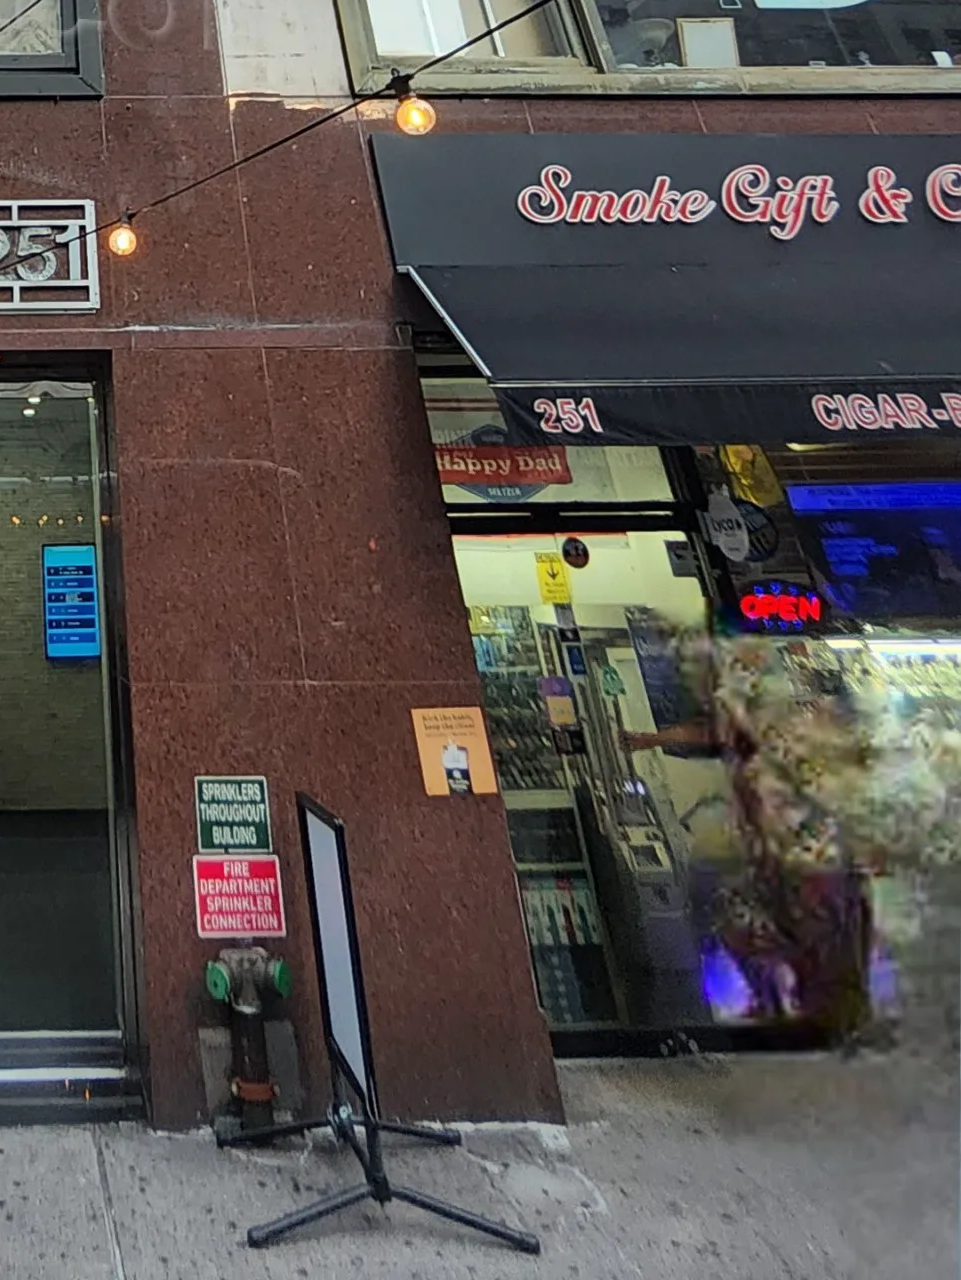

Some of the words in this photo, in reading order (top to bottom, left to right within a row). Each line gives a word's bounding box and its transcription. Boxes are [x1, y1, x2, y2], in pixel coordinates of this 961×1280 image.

[518, 164, 716, 224] Smoke
[722, 164, 839, 240] Gift
[859, 166, 913, 223] &
[533, 397, 604, 434] 251
[435, 451, 511, 475] Happy
[517, 451, 562, 472] Dad
[740, 594, 822, 622] OPEN
[201, 782, 261, 802] SPRINKLERS
[200, 803, 265, 823] THROUGHOUT
[212, 825, 257, 846] BUILDING
[223, 861, 250, 878] FIRE
[200, 878, 276, 896] DEPARTMENT
[206, 895, 272, 912] SPRINKLER
[203, 912, 278, 930] CONNECTION
